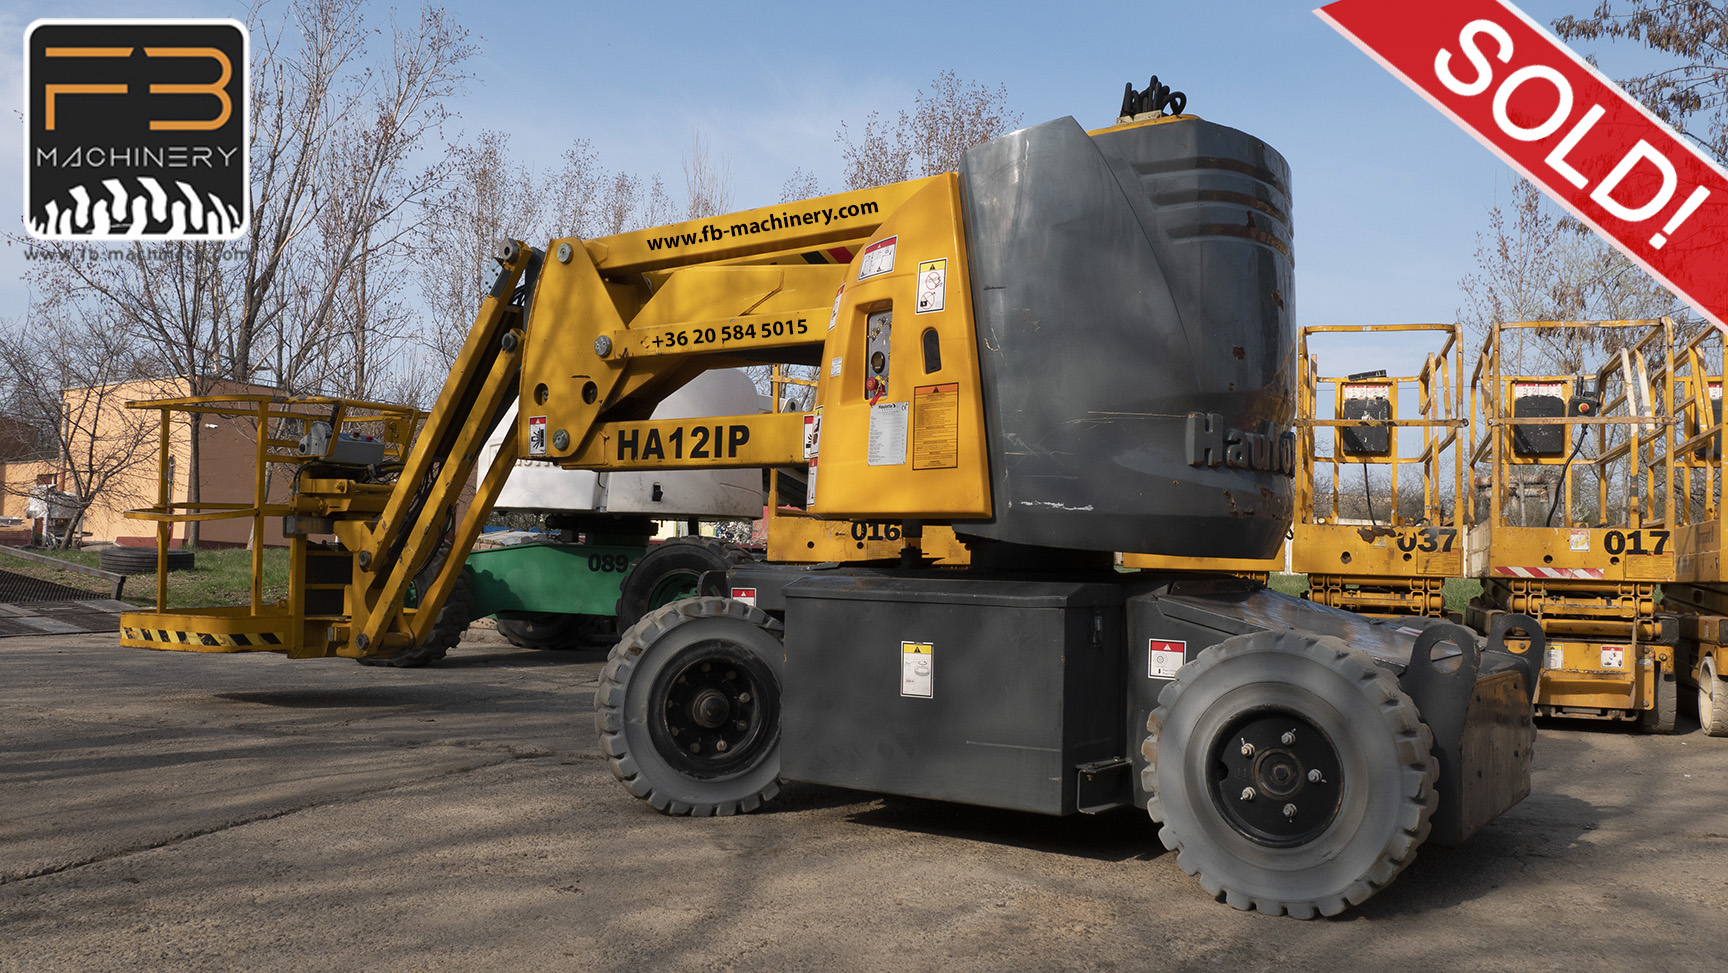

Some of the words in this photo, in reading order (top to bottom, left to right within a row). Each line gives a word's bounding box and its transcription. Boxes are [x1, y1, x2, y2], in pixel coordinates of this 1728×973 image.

[647, 200, 879, 252] www.fb-machinery.com
[651, 327, 689, 348] +36
[693, 328, 716, 345] 20
[721, 323, 757, 343] 584
[761, 318, 809, 339] 5015
[617, 426, 750, 461] HA12IP
[1185, 411, 1296, 479] Haulo
[851, 521, 900, 541] 016
[1397, 528, 1457, 552] 037
[1604, 530, 1670, 555] 017
[587, 553, 628, 573] 089
